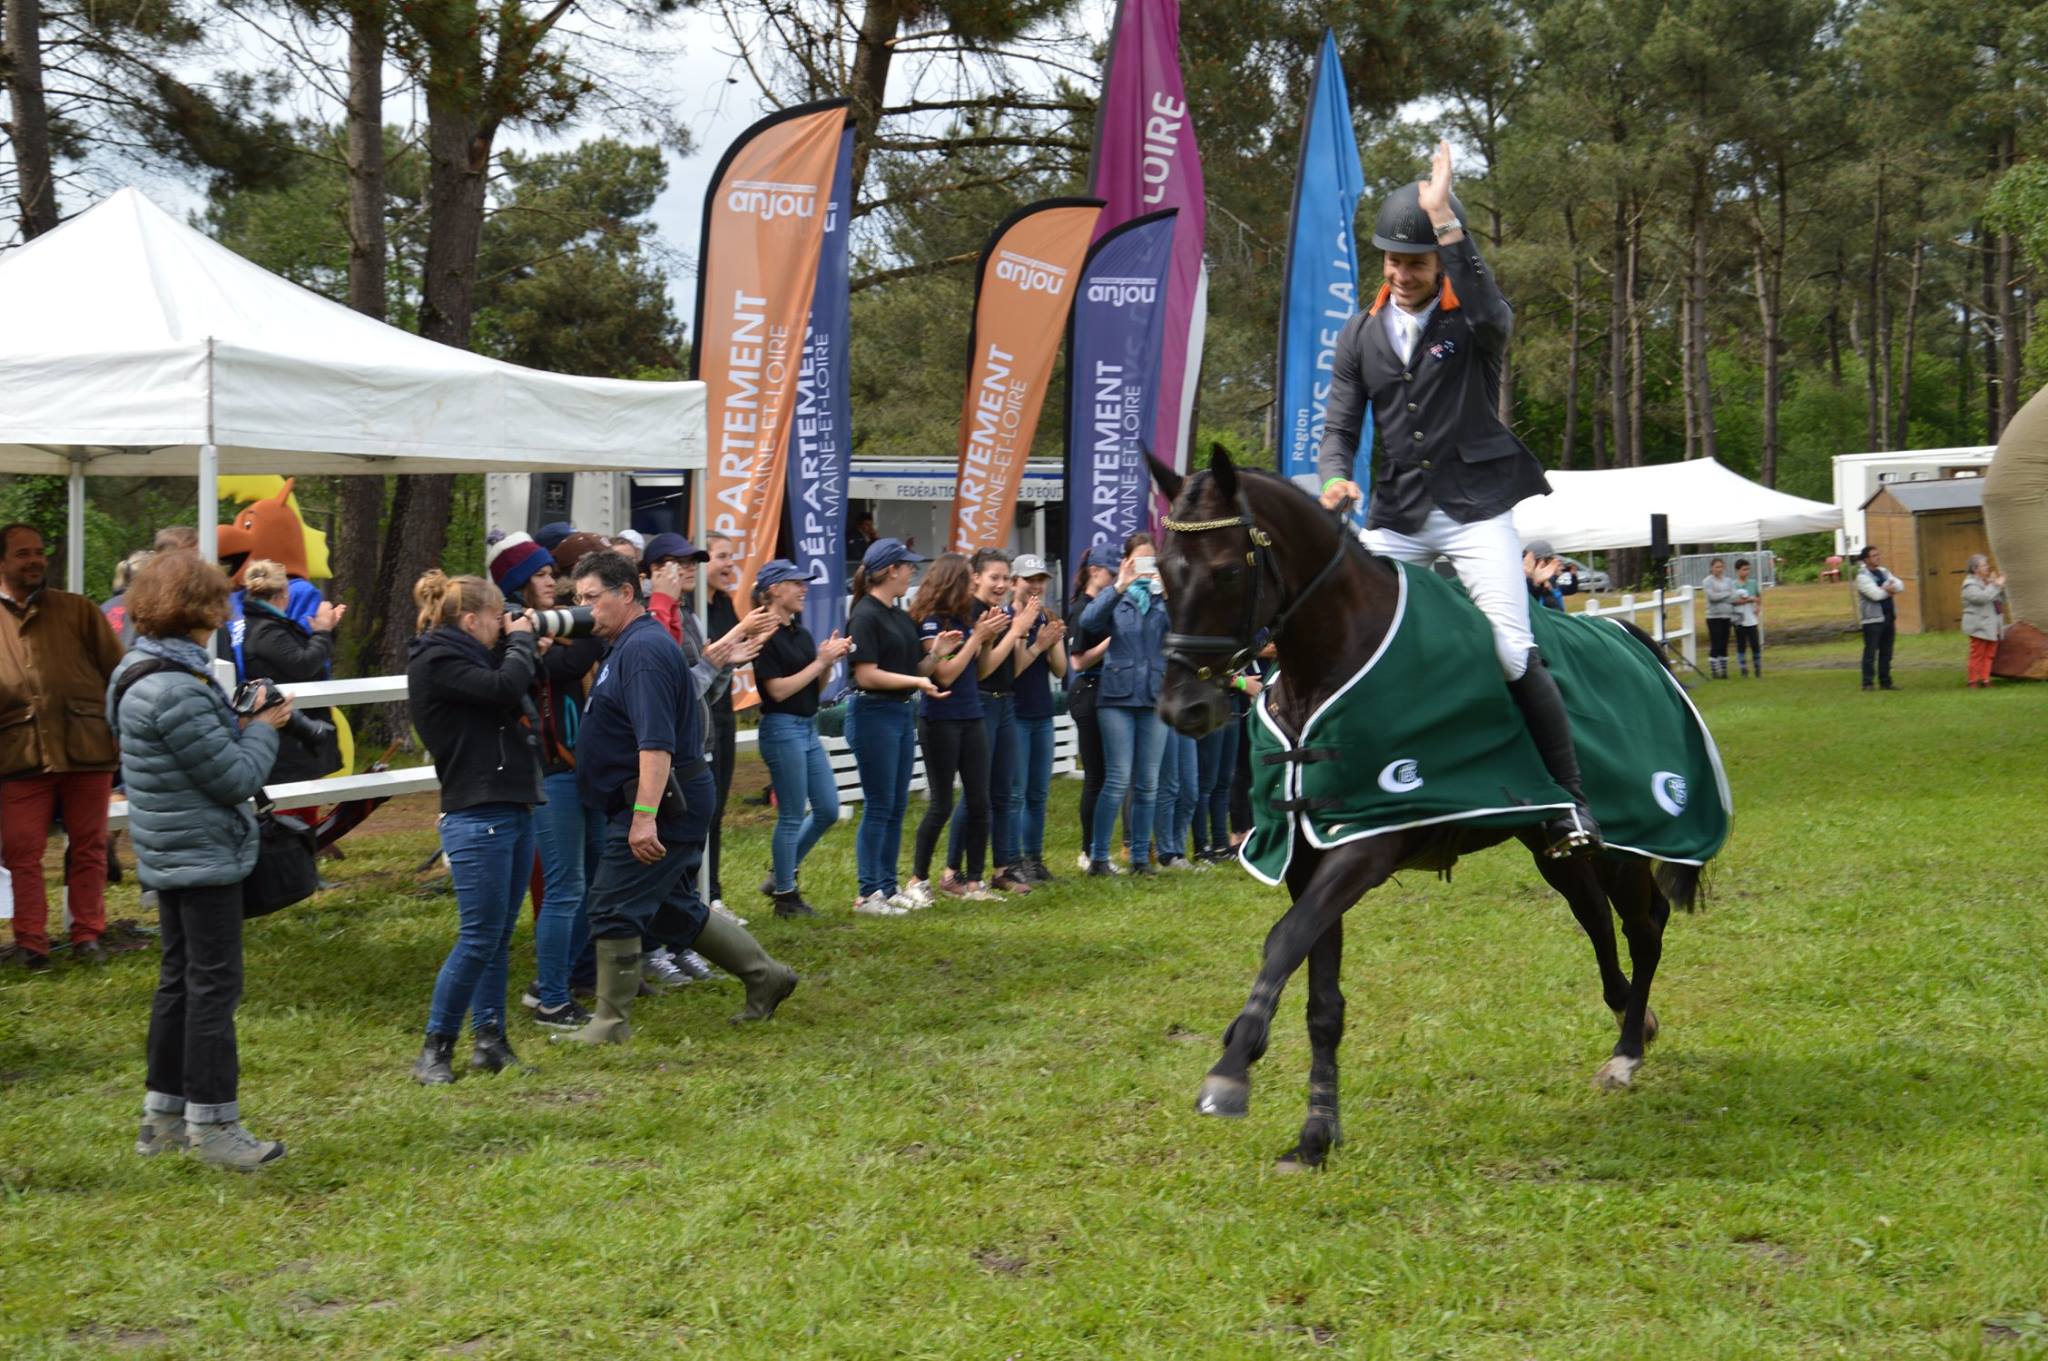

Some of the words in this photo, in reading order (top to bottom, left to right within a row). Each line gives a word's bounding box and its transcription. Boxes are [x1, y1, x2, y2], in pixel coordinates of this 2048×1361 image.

[1143, 91, 1186, 204] LOIRE
[728, 191, 815, 220] anjou
[996, 260, 1064, 294] anjou
[1087, 283, 1157, 307] anjou
[1324, 282, 1355, 320] LA
[796, 312, 830, 585] DÉPARTEME
[956, 343, 1014, 558] PARTEMENT
[979, 379, 1028, 540] MAINE-ET-LOIRE
[1291, 408, 1310, 462] Région
